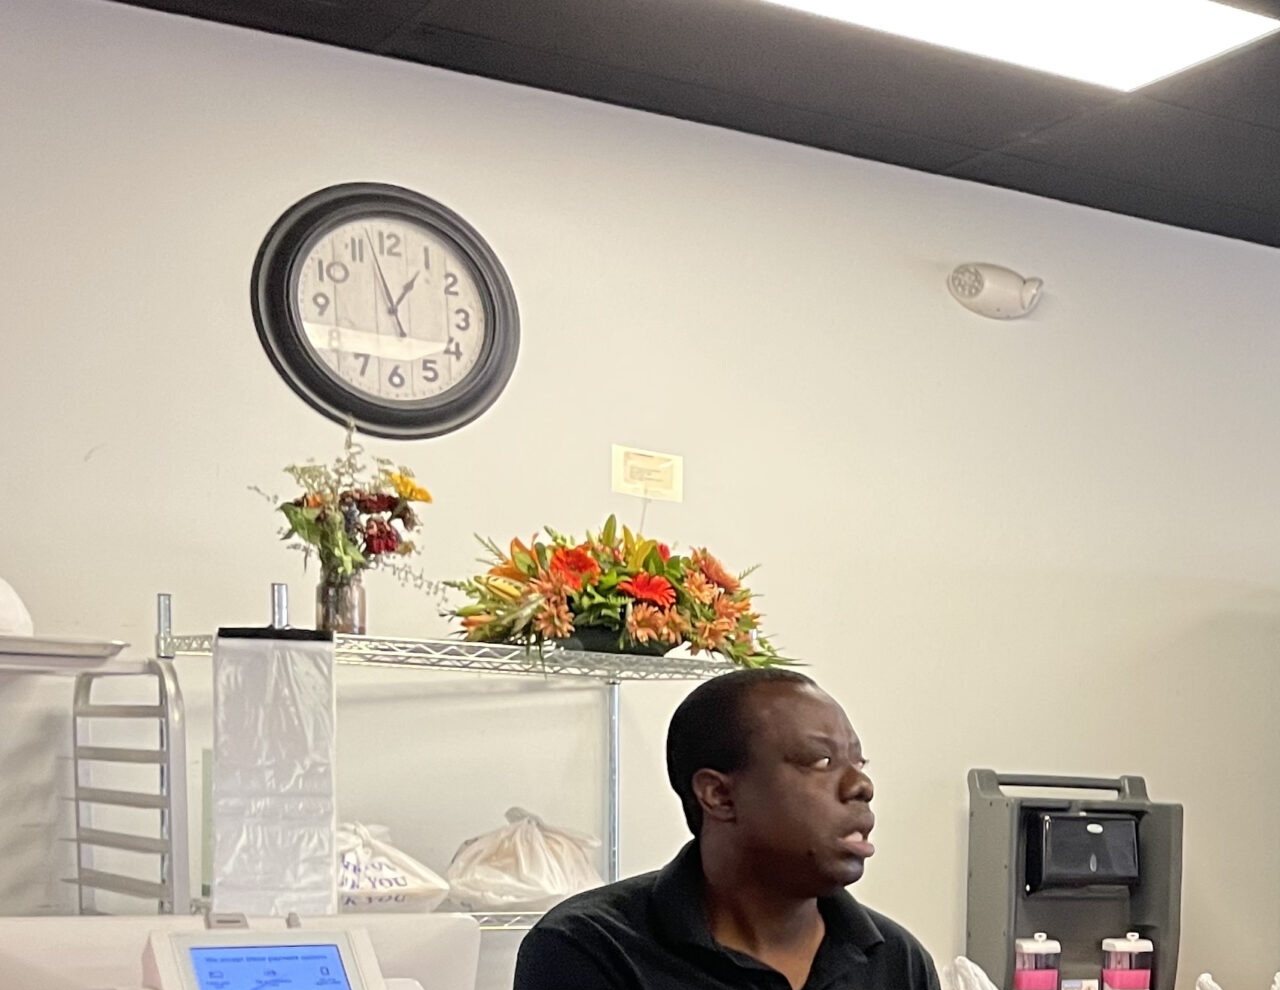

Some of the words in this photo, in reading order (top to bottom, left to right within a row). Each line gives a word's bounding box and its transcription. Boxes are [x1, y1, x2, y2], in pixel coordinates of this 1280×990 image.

[350, 237, 365, 262] 11
[378, 230, 402, 257] 12
[423, 246, 431, 270] 1
[317, 259, 350, 284] 10
[443, 273, 459, 296] 2
[312, 292, 330, 316] 9
[454, 308, 471, 331] 3
[328, 329, 342, 350] 8
[443, 337, 463, 361] 4
[354, 354, 371, 376] 7
[388, 365, 405, 388] 6
[422, 359, 440, 382] 5
[367, 875, 408, 889] YOU
